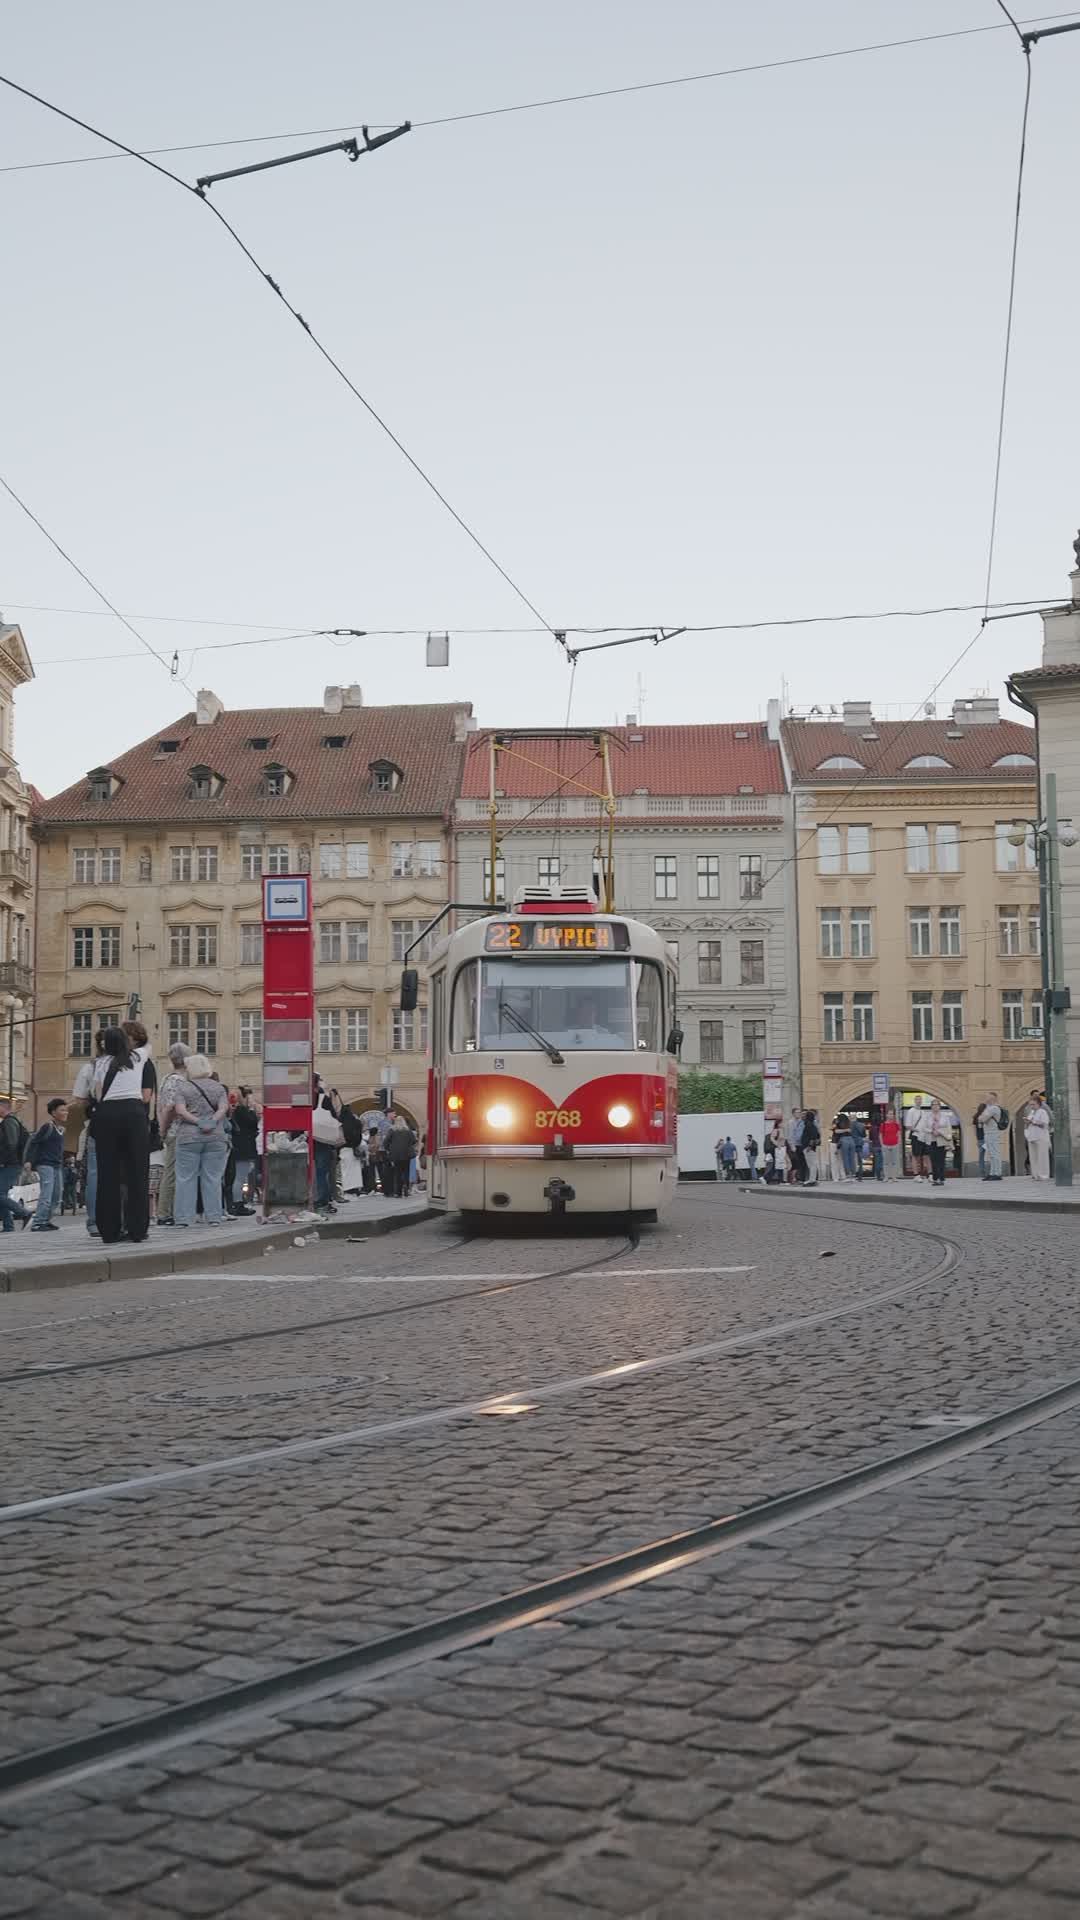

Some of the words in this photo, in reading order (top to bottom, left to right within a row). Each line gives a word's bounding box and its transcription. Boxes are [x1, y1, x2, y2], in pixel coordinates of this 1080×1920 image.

[488, 923, 521, 948] 22
[537, 927, 609, 948] VYPICH
[535, 1110, 581, 1128] 8768
